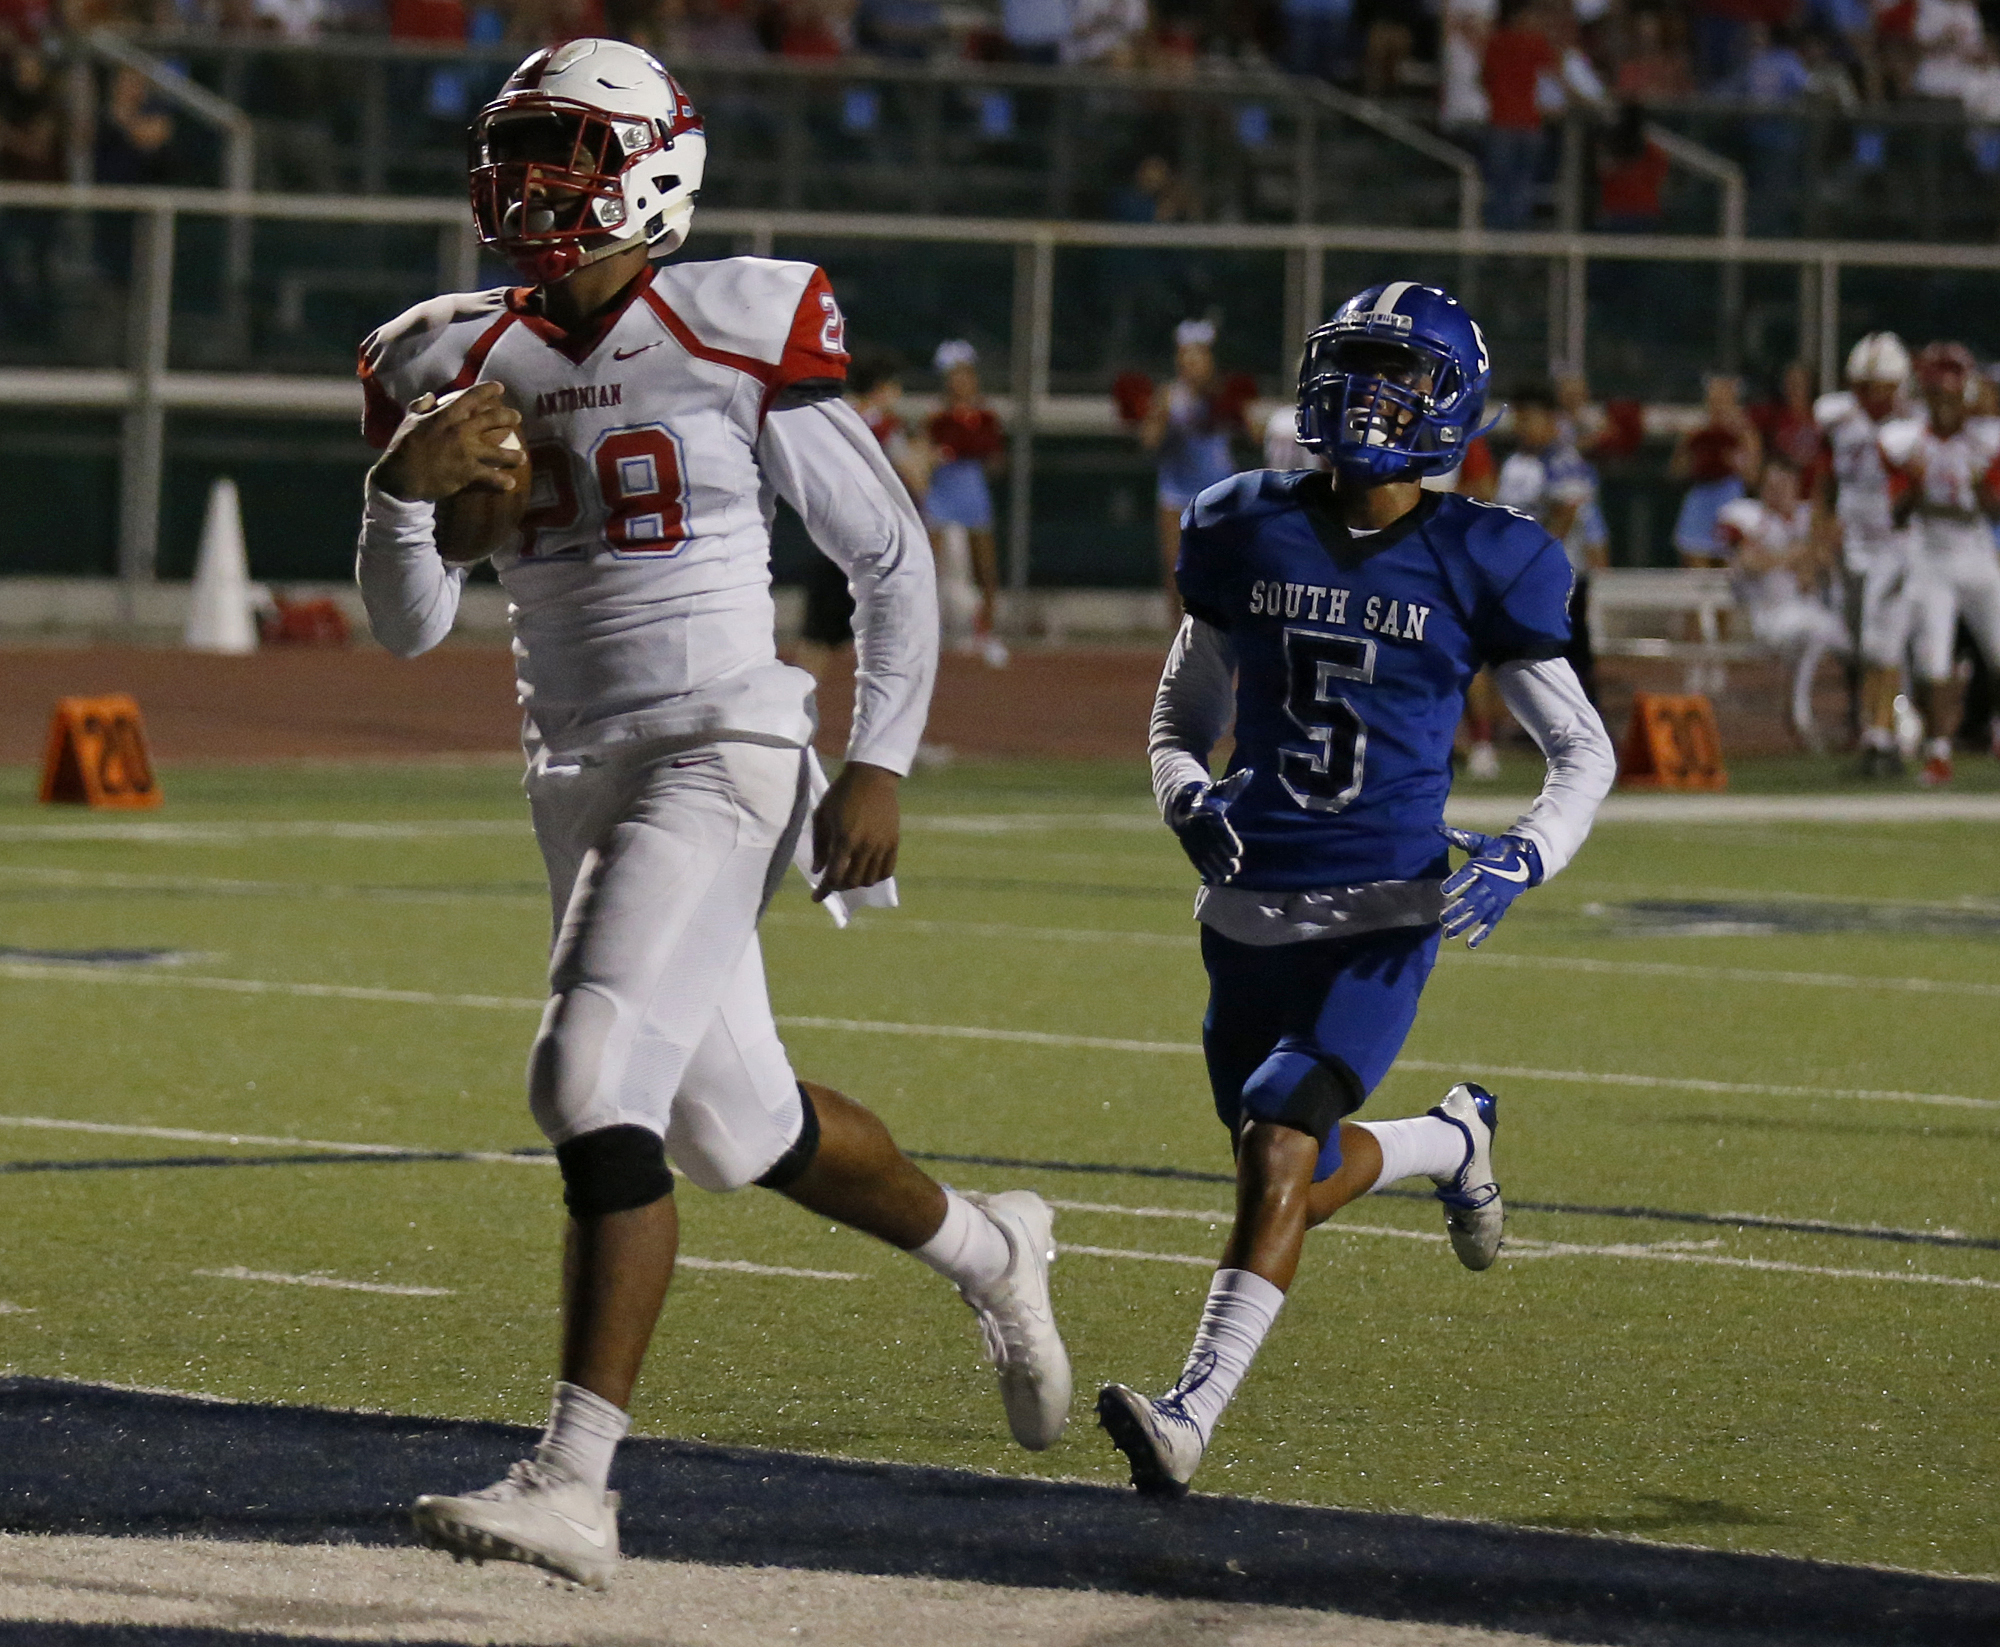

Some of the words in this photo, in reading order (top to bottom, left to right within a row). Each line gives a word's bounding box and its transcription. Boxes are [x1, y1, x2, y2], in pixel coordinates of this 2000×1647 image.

[818, 291, 847, 354] 2
[535, 383, 622, 418] ANTONIAN
[517, 420, 694, 564] 28
[1249, 579, 1350, 625] SOUTH
[1363, 595, 1430, 641] SAN
[1277, 627, 1377, 814] 5
